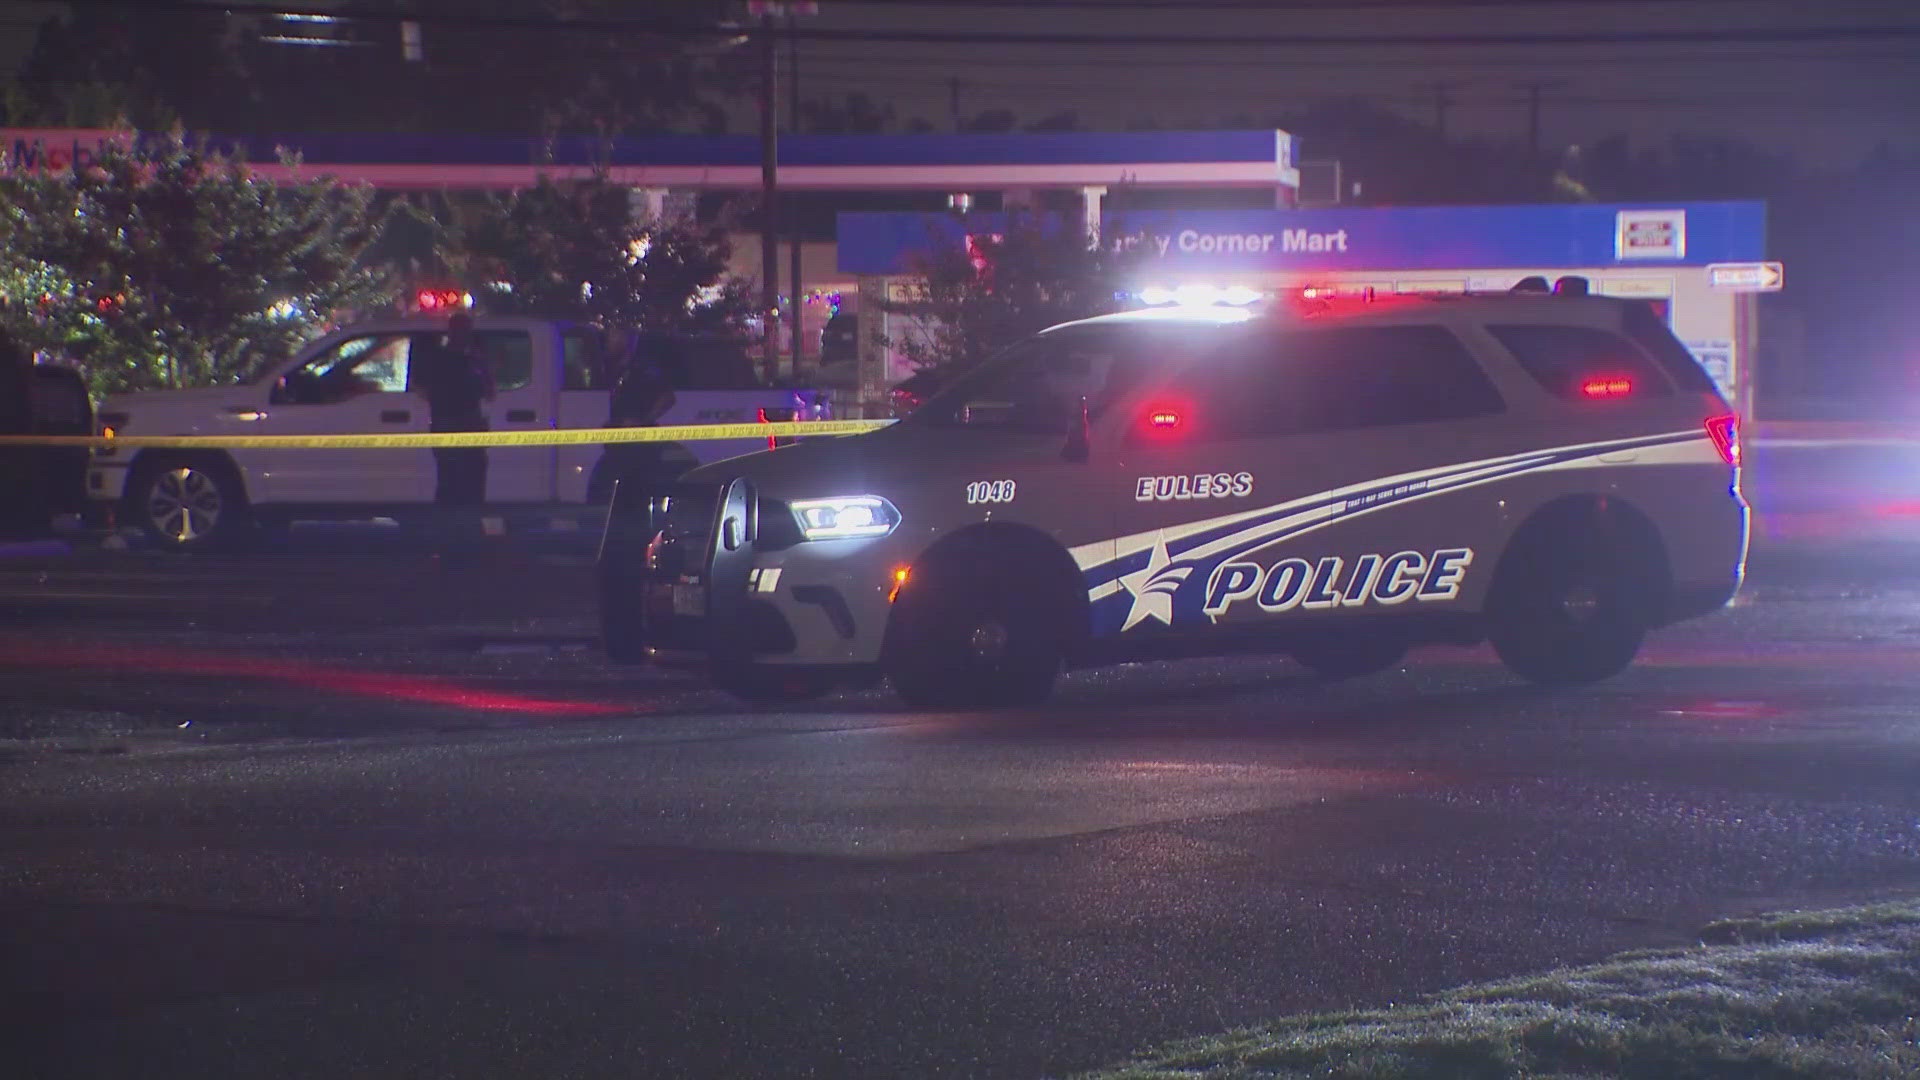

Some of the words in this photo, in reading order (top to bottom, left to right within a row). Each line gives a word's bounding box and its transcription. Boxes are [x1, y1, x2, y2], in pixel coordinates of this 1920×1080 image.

[14, 137, 107, 173] Mobi
[1178, 229, 1274, 253] Corner
[1282, 228, 1348, 252] Mart
[966, 479, 1017, 505] 1048
[1135, 471, 1254, 502] EULESS
[1377, 489, 1394, 500] SERVE
[1394, 486, 1408, 495] WITH
[1203, 547, 1474, 618] POLICE
